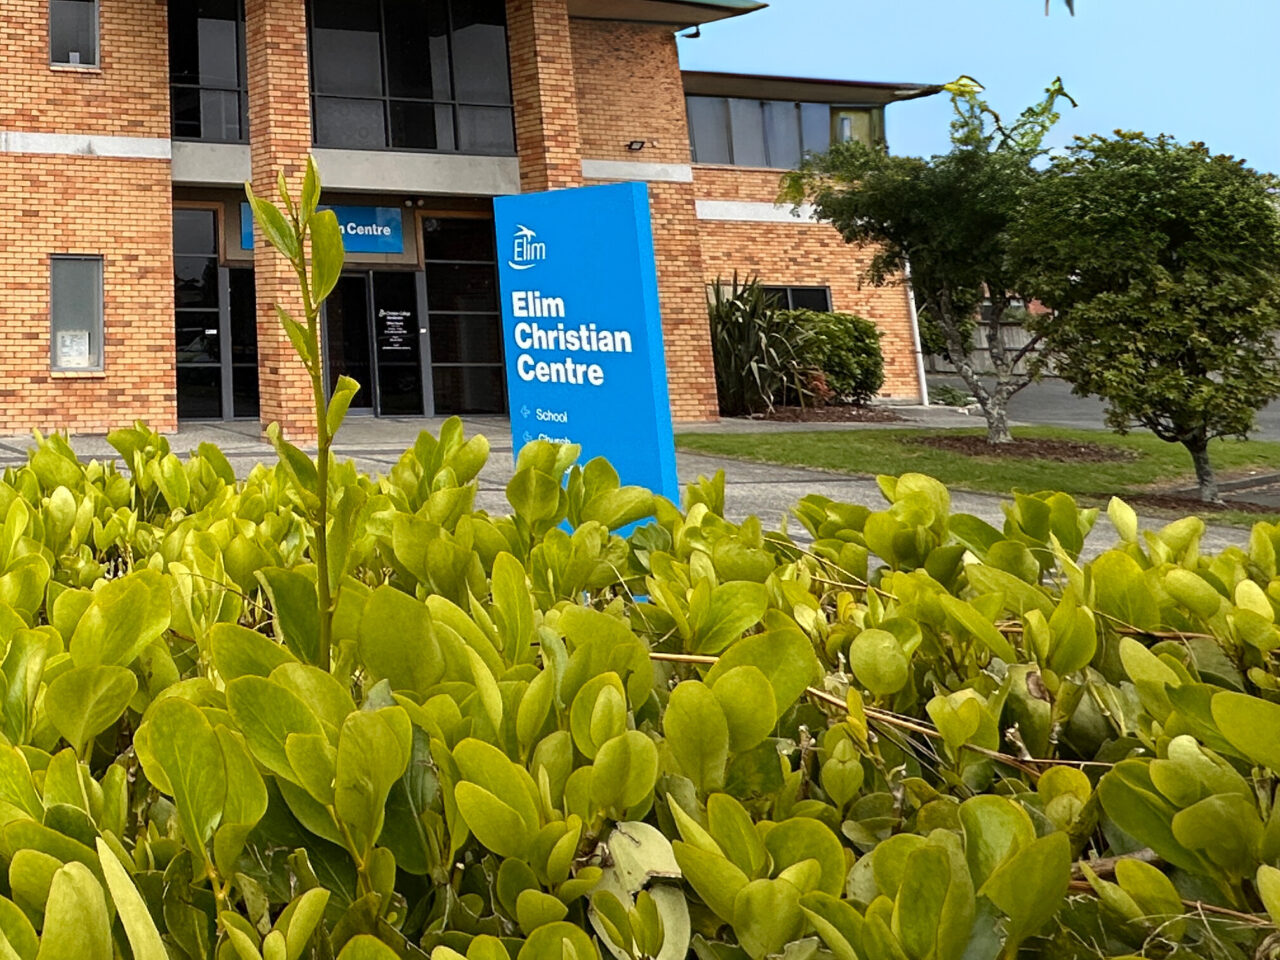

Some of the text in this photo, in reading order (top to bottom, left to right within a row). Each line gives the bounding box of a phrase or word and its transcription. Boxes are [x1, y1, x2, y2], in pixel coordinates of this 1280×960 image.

[346, 222, 391, 236] Centre
[514, 236, 546, 261] Elim
[512, 291, 565, 317] Elim
[514, 322, 632, 352] Christian
[517, 354, 604, 386] Centre
[536, 408, 568, 423] School
